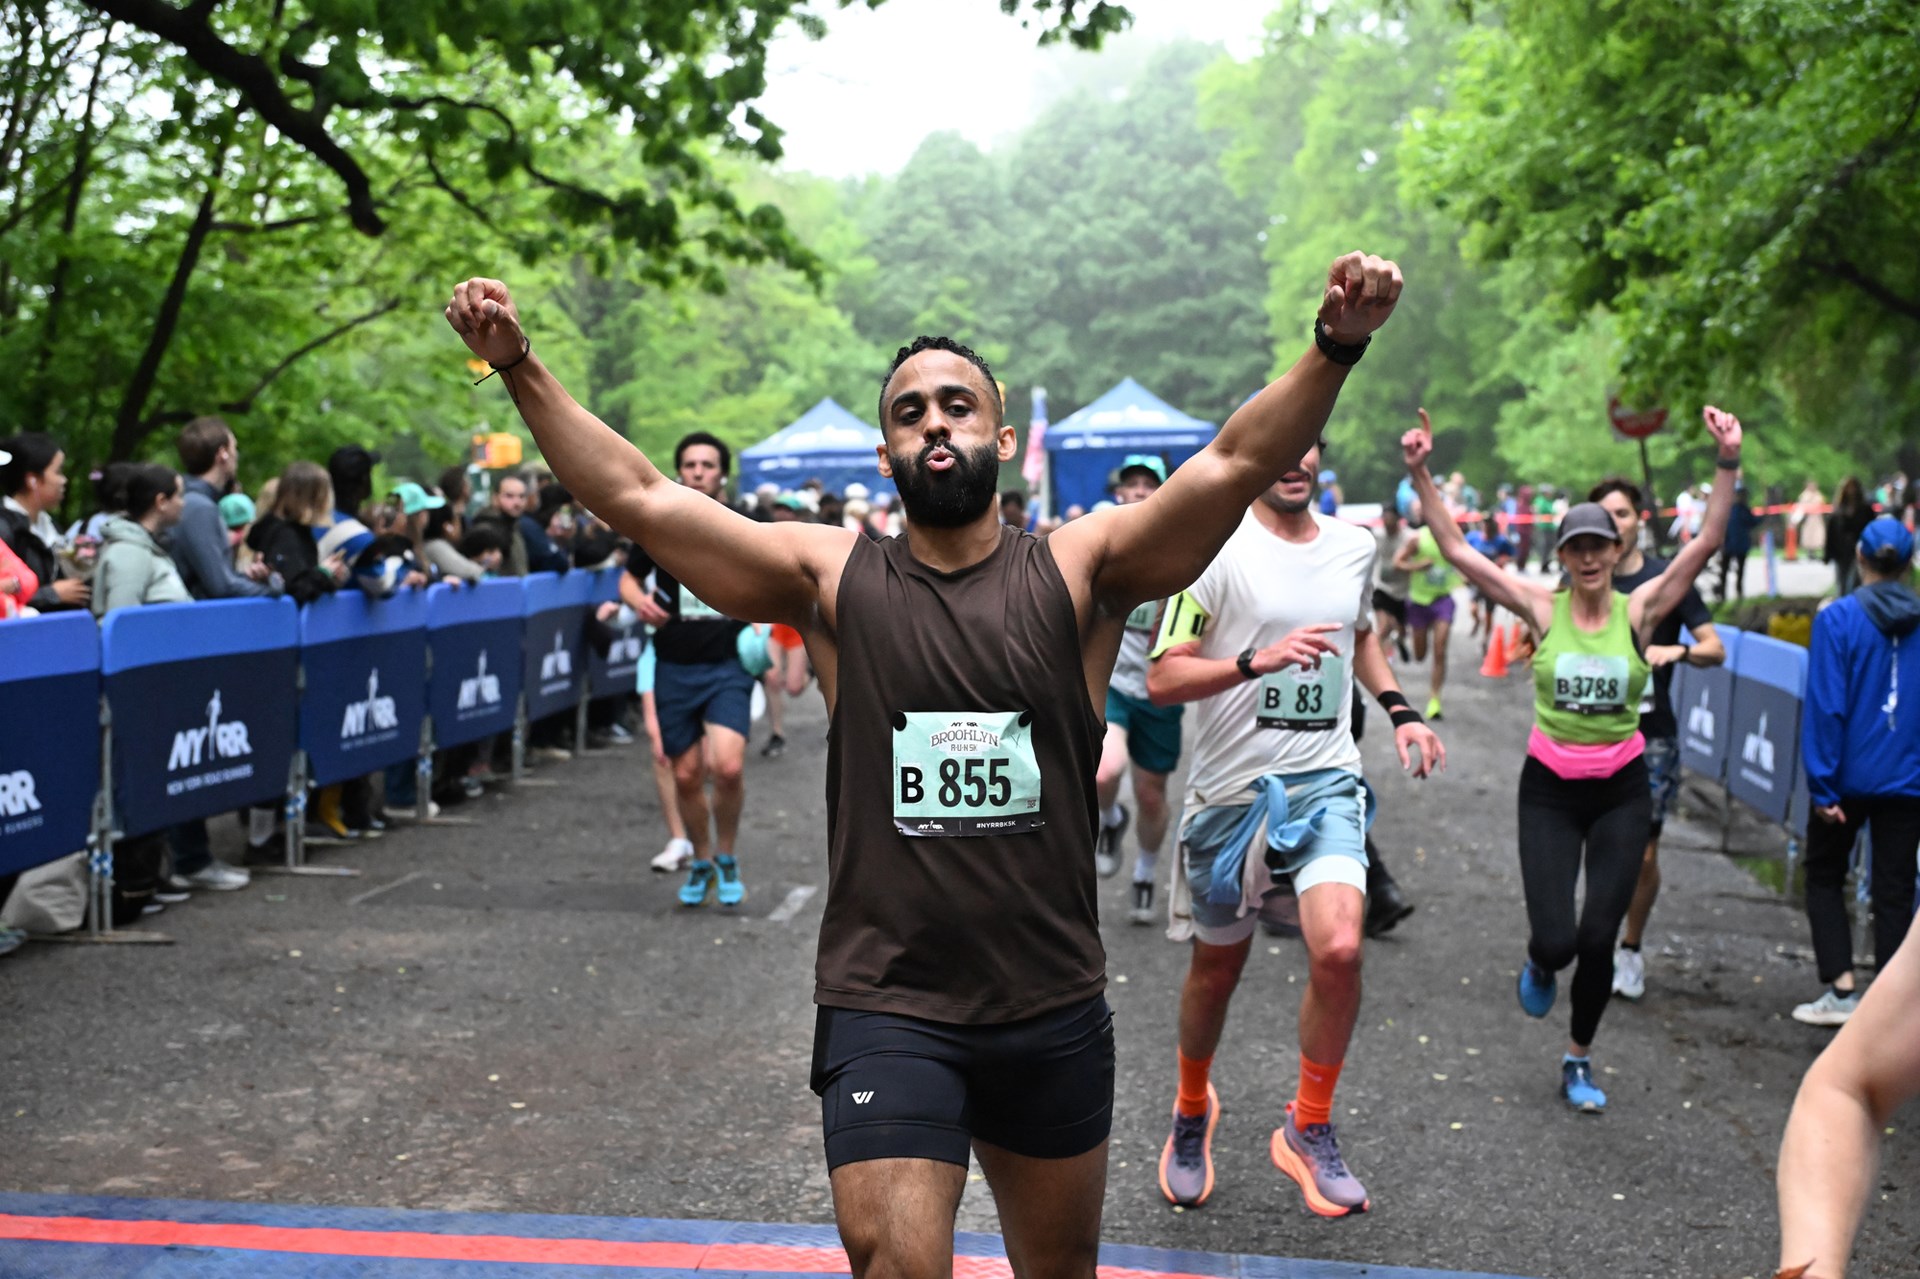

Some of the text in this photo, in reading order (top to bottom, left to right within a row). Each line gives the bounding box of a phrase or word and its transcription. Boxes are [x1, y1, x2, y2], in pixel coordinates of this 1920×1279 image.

[1265, 684, 1323, 713] B 83
[931, 729, 998, 747] BROOKLYN
[901, 766, 925, 803] B
[938, 758, 1012, 807] 855
[976, 820, 1016, 829] #NYRRBK5K
